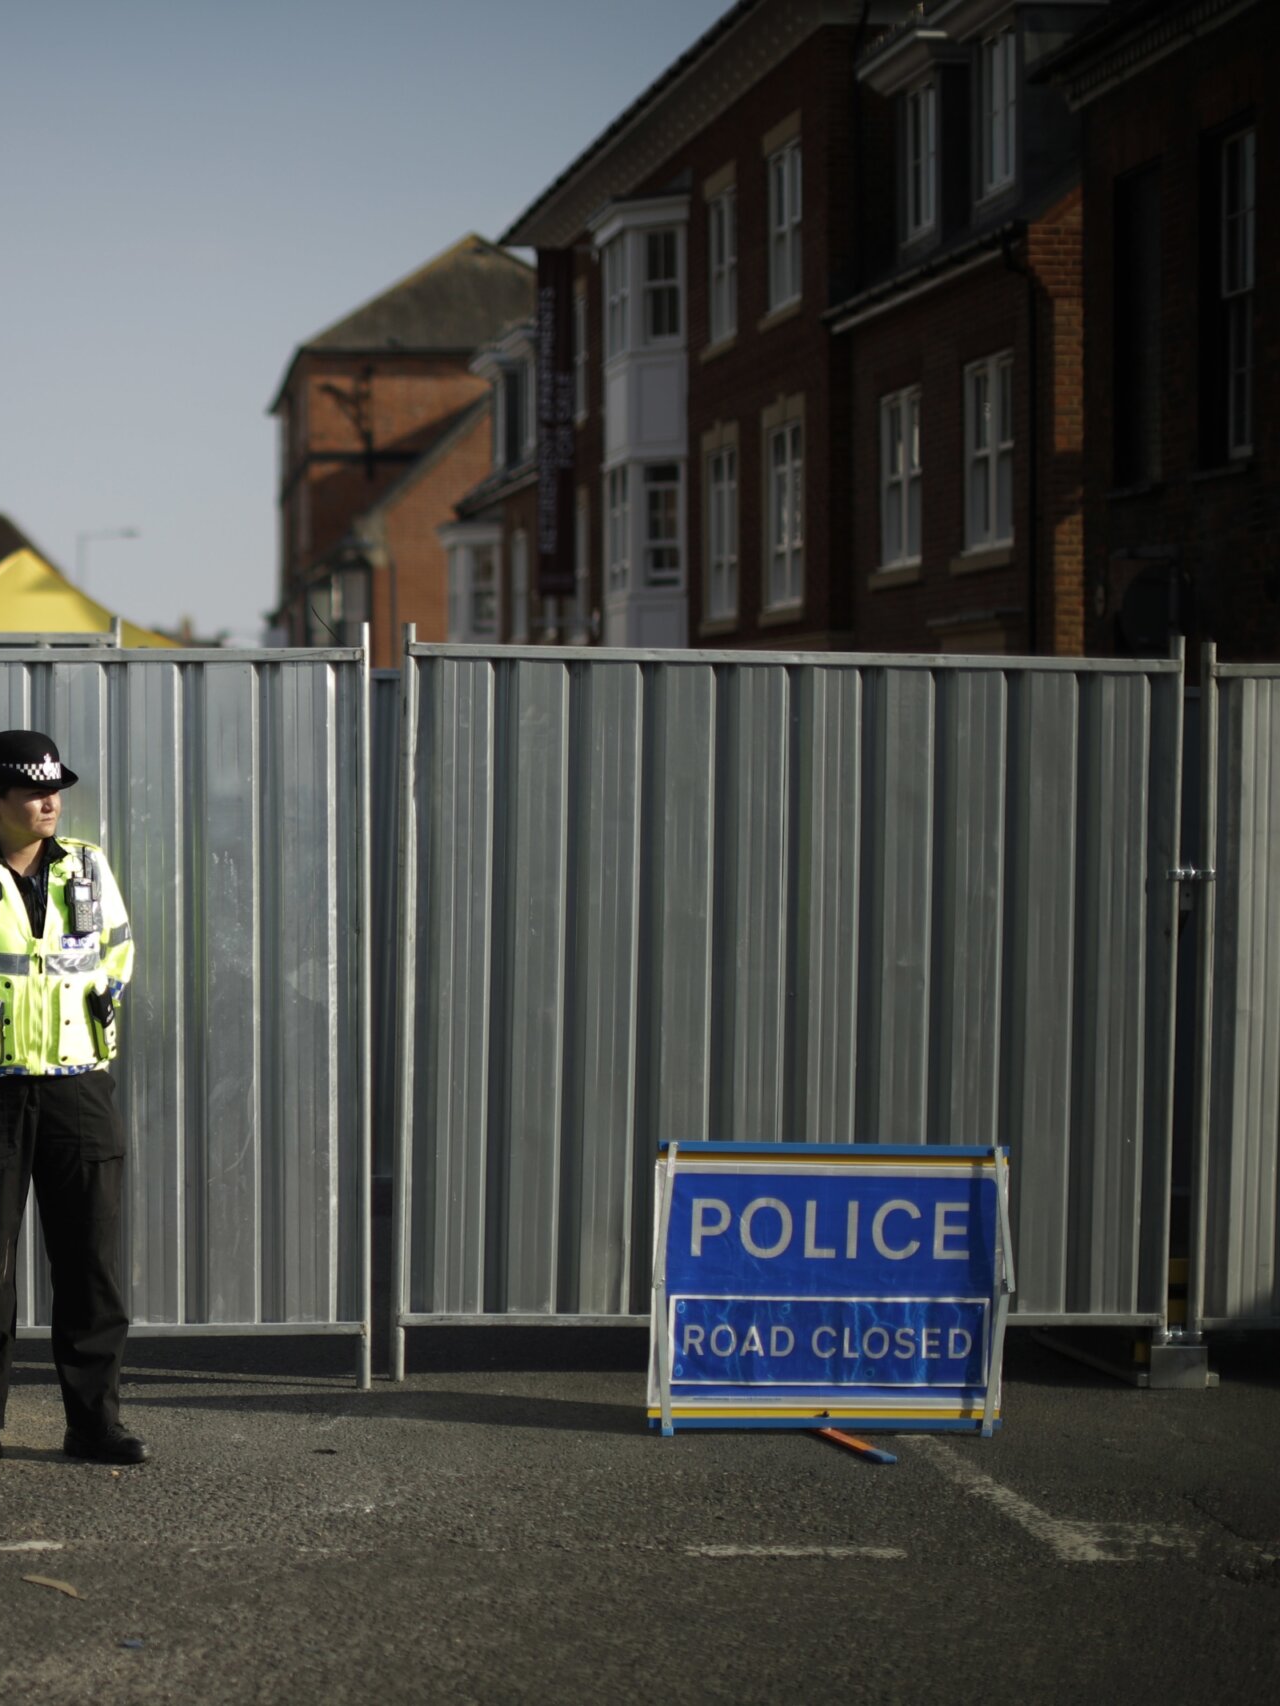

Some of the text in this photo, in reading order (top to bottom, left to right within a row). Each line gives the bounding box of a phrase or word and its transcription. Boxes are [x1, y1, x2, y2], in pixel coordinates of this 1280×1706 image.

[690, 1197, 970, 1260] POLICE
[682, 1324, 973, 1359] ROAD CLOSED
